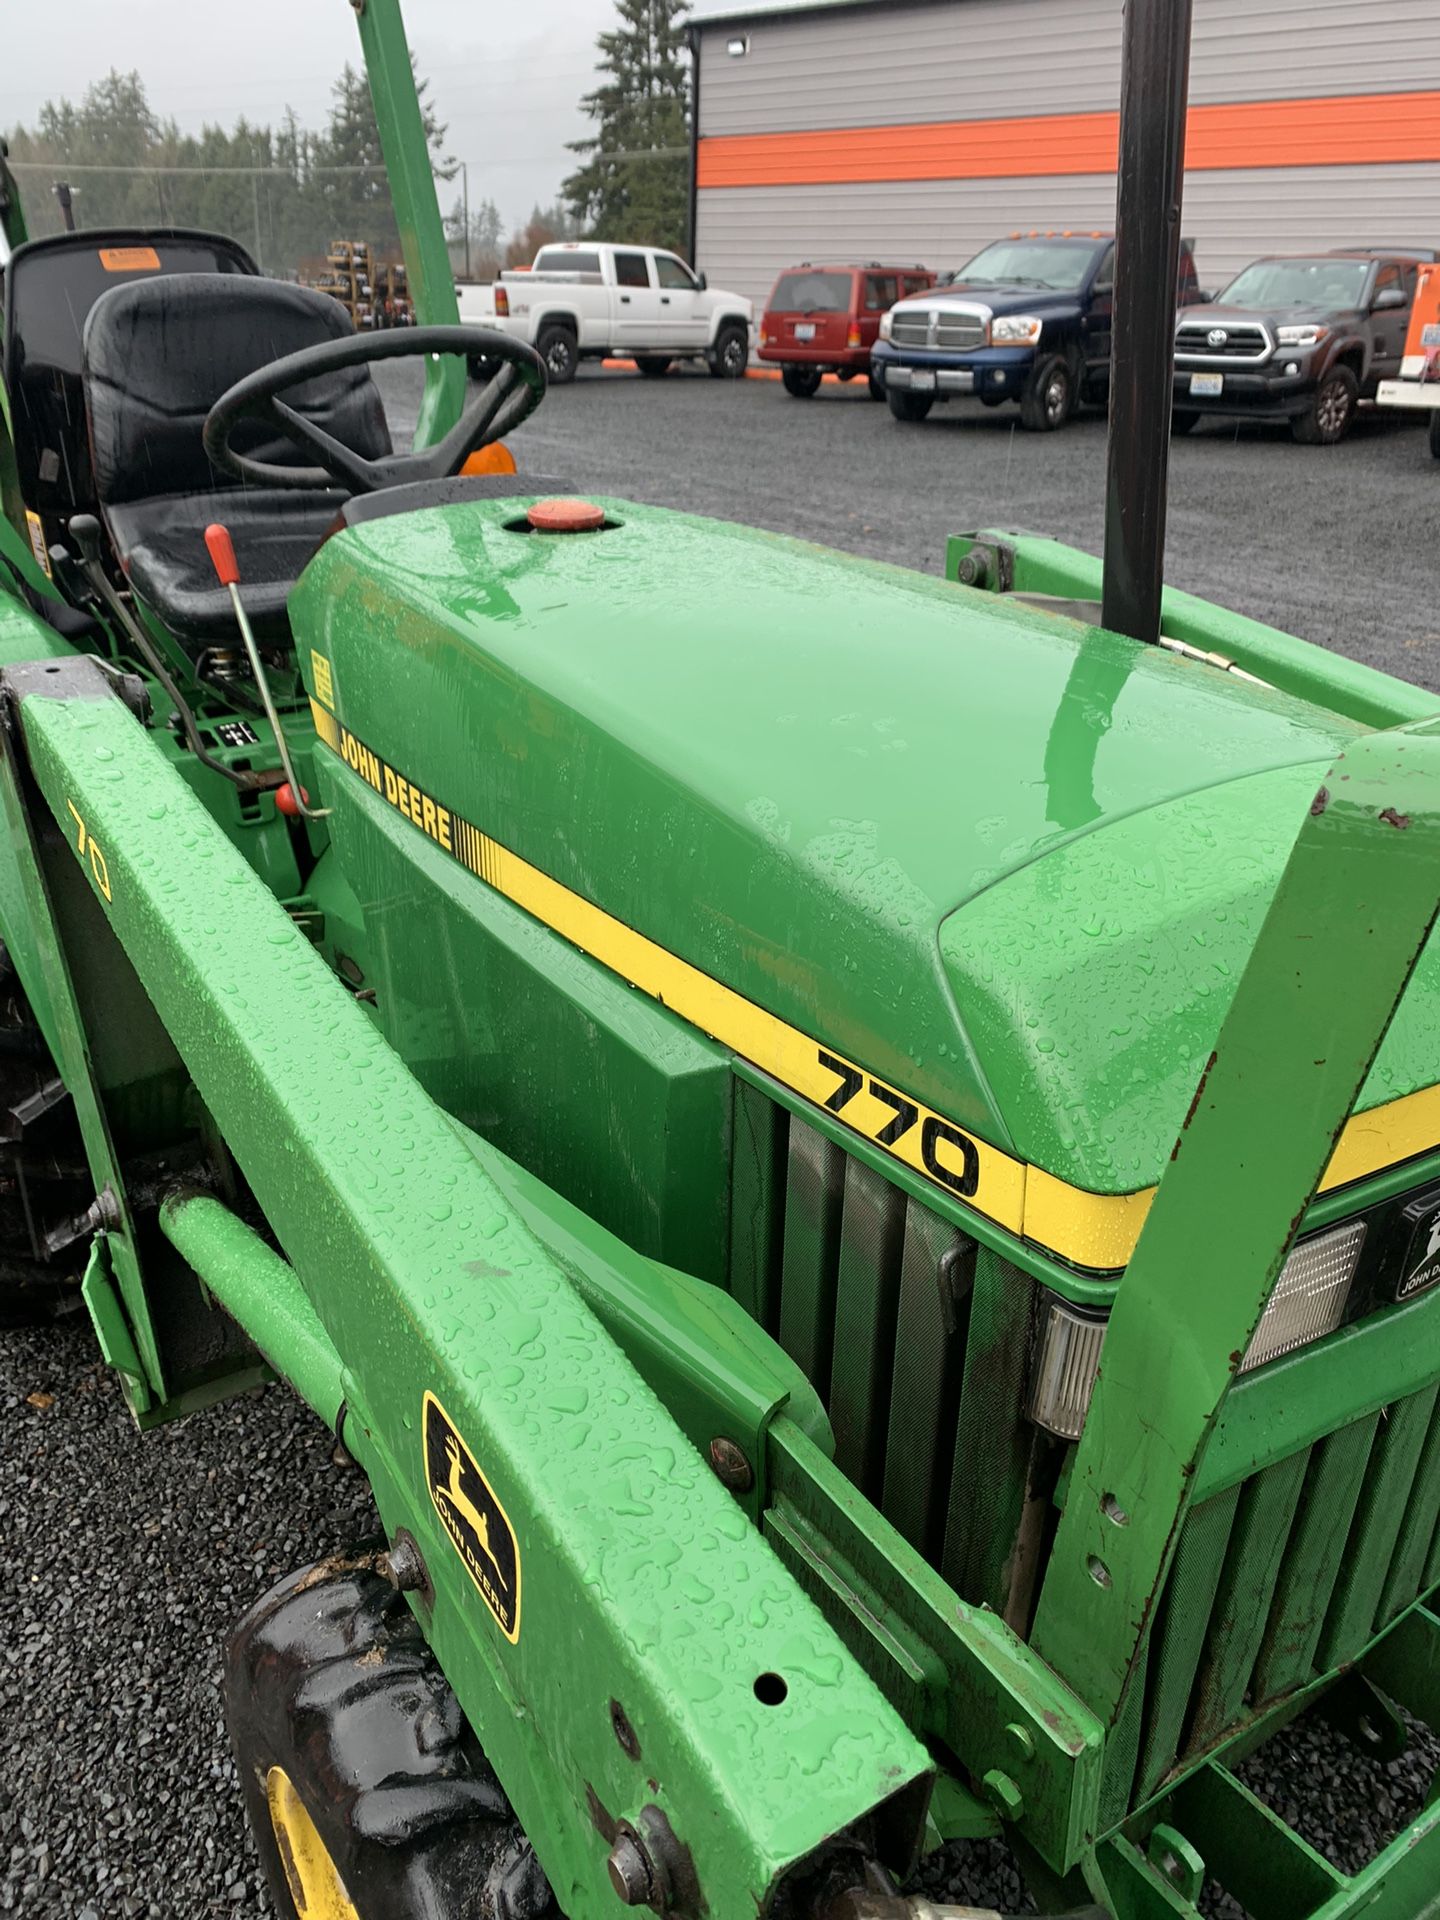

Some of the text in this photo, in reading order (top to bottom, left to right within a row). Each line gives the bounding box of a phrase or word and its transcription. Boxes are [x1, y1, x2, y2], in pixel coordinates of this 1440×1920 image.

[340, 727, 452, 851] JOHN DEERE
[818, 1048, 980, 1198] 770
[1401, 1269, 1430, 1294] JOHN
[433, 1490, 508, 1628] JOHN DEERE
